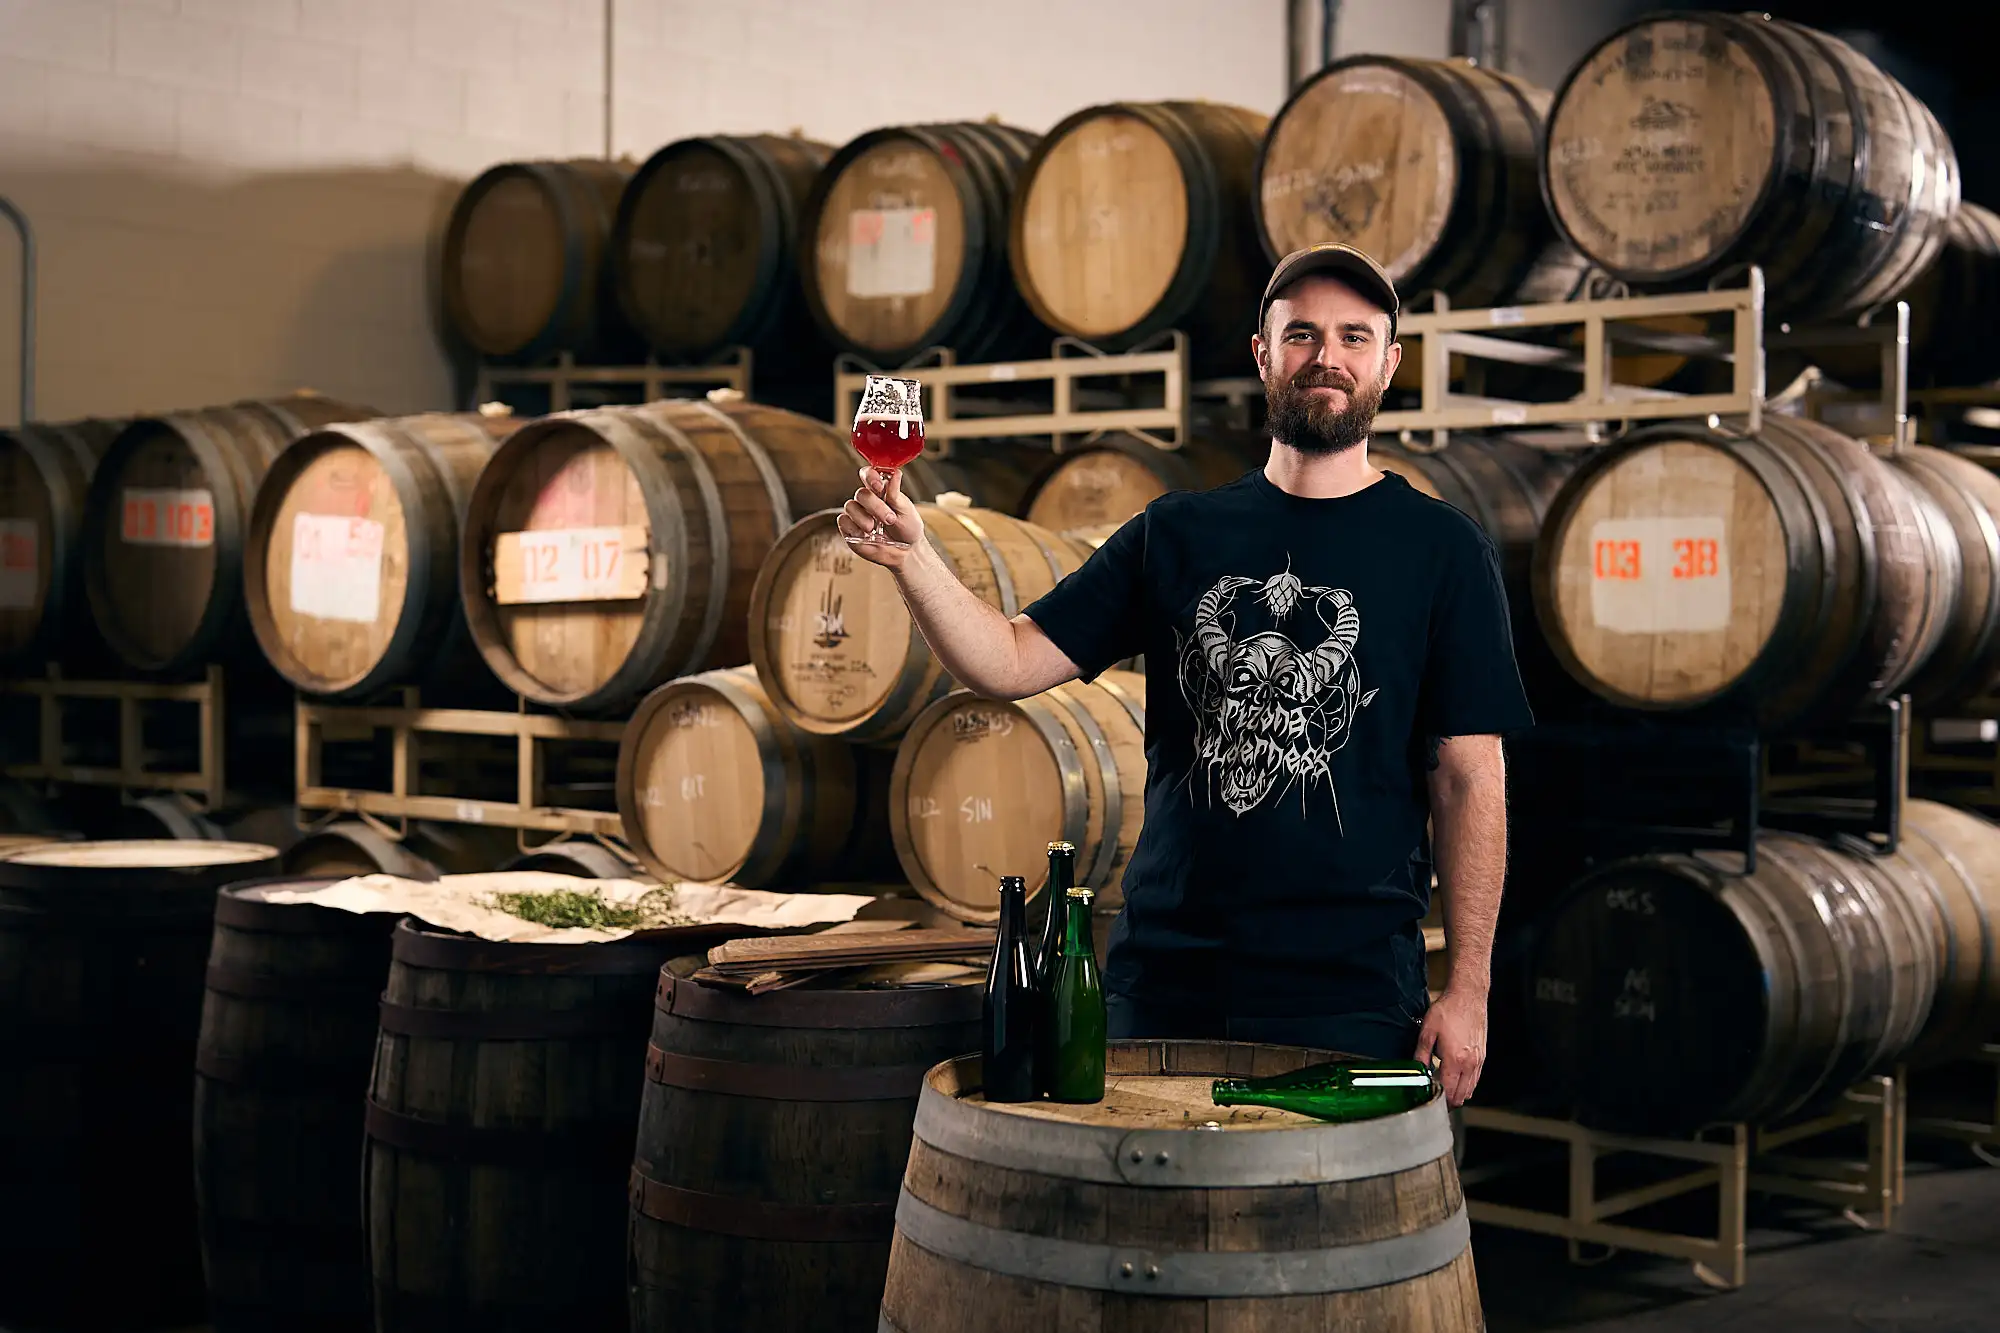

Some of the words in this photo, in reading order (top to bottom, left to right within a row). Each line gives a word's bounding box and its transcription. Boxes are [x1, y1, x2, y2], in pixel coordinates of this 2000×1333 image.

[581, 540, 621, 581] 07
[1596, 539, 1640, 579] 03
[1672, 538, 1718, 579] 38
